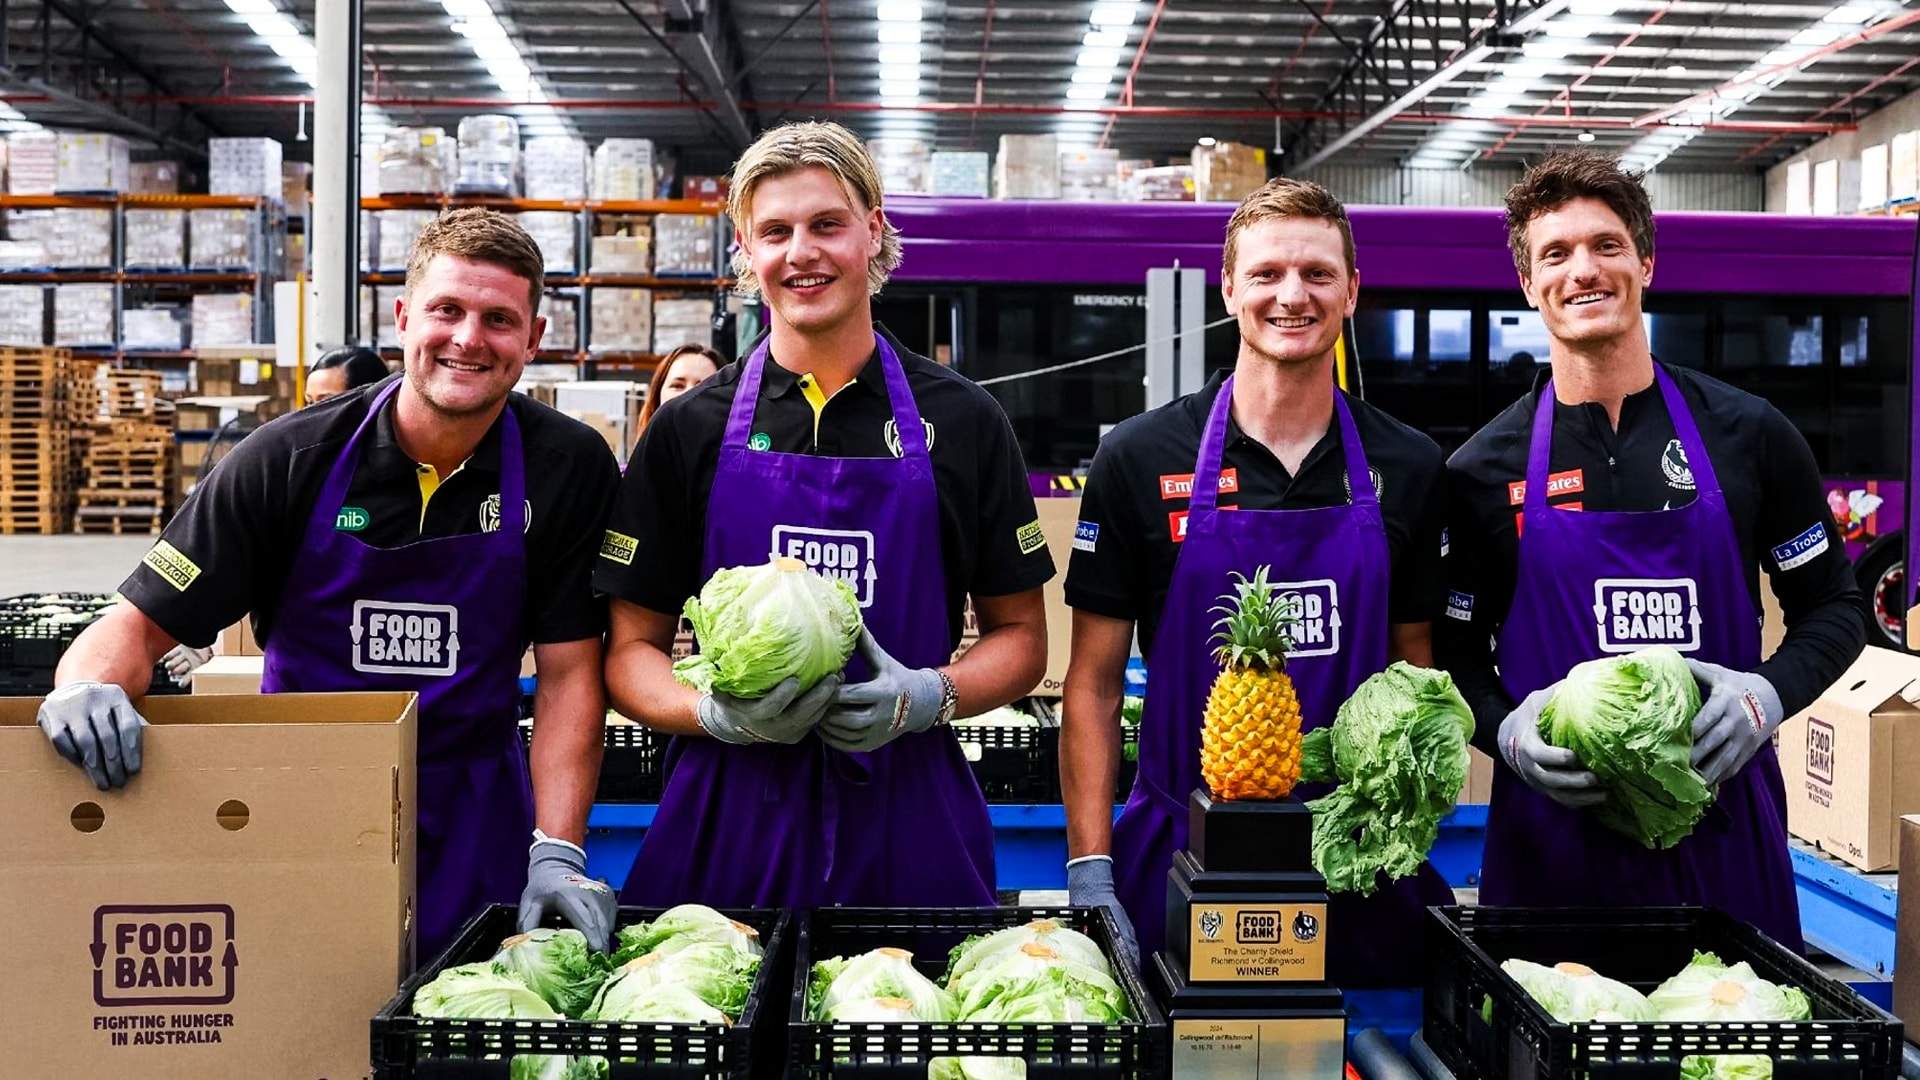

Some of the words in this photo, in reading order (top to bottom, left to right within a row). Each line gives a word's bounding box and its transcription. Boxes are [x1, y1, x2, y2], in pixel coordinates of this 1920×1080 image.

[1074, 295, 1134, 306] EMERGENCY
[1163, 476, 1235, 494] Emes
[1512, 476, 1580, 500] Eates
[336, 511, 365, 528] nib
[786, 539, 859, 569] FOOD
[1776, 549, 1792, 560] La
[1791, 529, 1824, 552] Trobe
[147, 551, 189, 585] STORAGE
[1611, 590, 1683, 616] FOOD
[369, 613, 441, 640] FOOD
[1613, 615, 1685, 639] BANK
[368, 637, 441, 663] BANK
[1810, 728, 1830, 753] FOOD
[1810, 748, 1830, 774] BANK
[1243, 916, 1275, 927] FOOD
[1243, 927, 1275, 938] BANK
[115, 922, 213, 955] FOOD
[1211, 957, 1250, 965] Richmond
[1258, 957, 1305, 966] Collingwood
[1223, 947, 1238, 955] The
[1240, 947, 1268, 957] Charity
[1269, 947, 1294, 955] Shield
[115, 955, 213, 989] BANK
[1236, 967, 1279, 976] WINNER
[93, 1014, 166, 1030] FIGHTING
[171, 1013, 234, 1028] HUNGER
[111, 1032, 128, 1046] IN
[133, 1030, 222, 1046] AUSTRALIA
